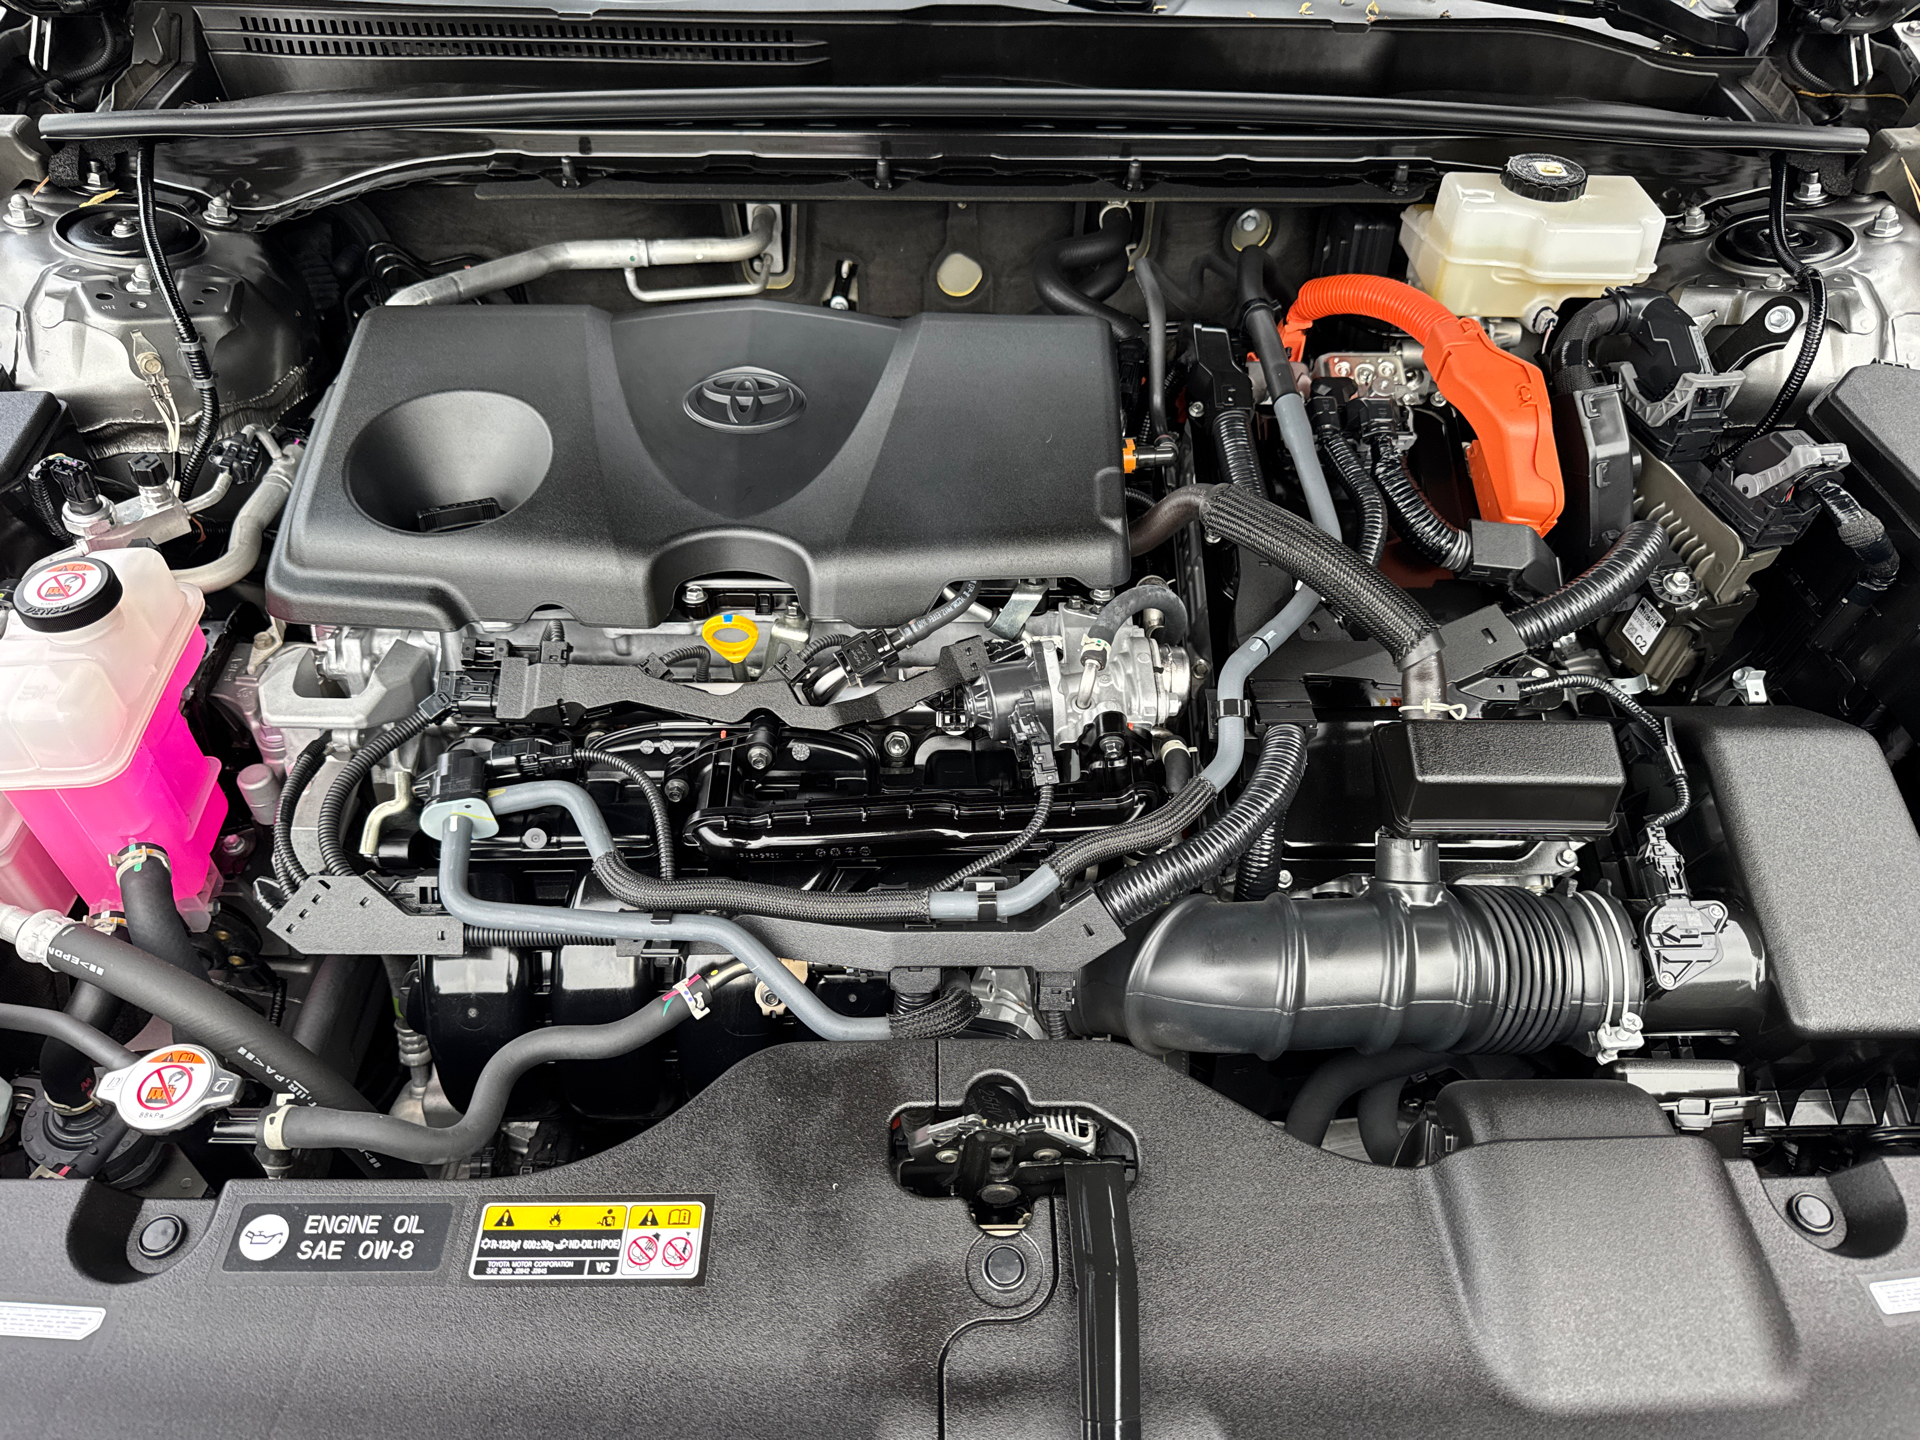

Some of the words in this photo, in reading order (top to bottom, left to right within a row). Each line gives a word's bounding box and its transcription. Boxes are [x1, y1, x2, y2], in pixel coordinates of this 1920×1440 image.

[24, 604, 70, 616] DENSO
[1634, 634, 1647, 651] C2
[138, 1111, 165, 1119] 88kPa
[304, 1215, 382, 1234] ENGINE
[393, 1215, 425, 1234] OIL
[296, 1240, 346, 1260] SAE
[358, 1240, 415, 1260] 0W-8
[488, 1260, 510, 1268] TOYOTA
[511, 1260, 533, 1268] MOTOR
[533, 1260, 574, 1268] CORPORATION
[595, 1261, 611, 1273] VC
